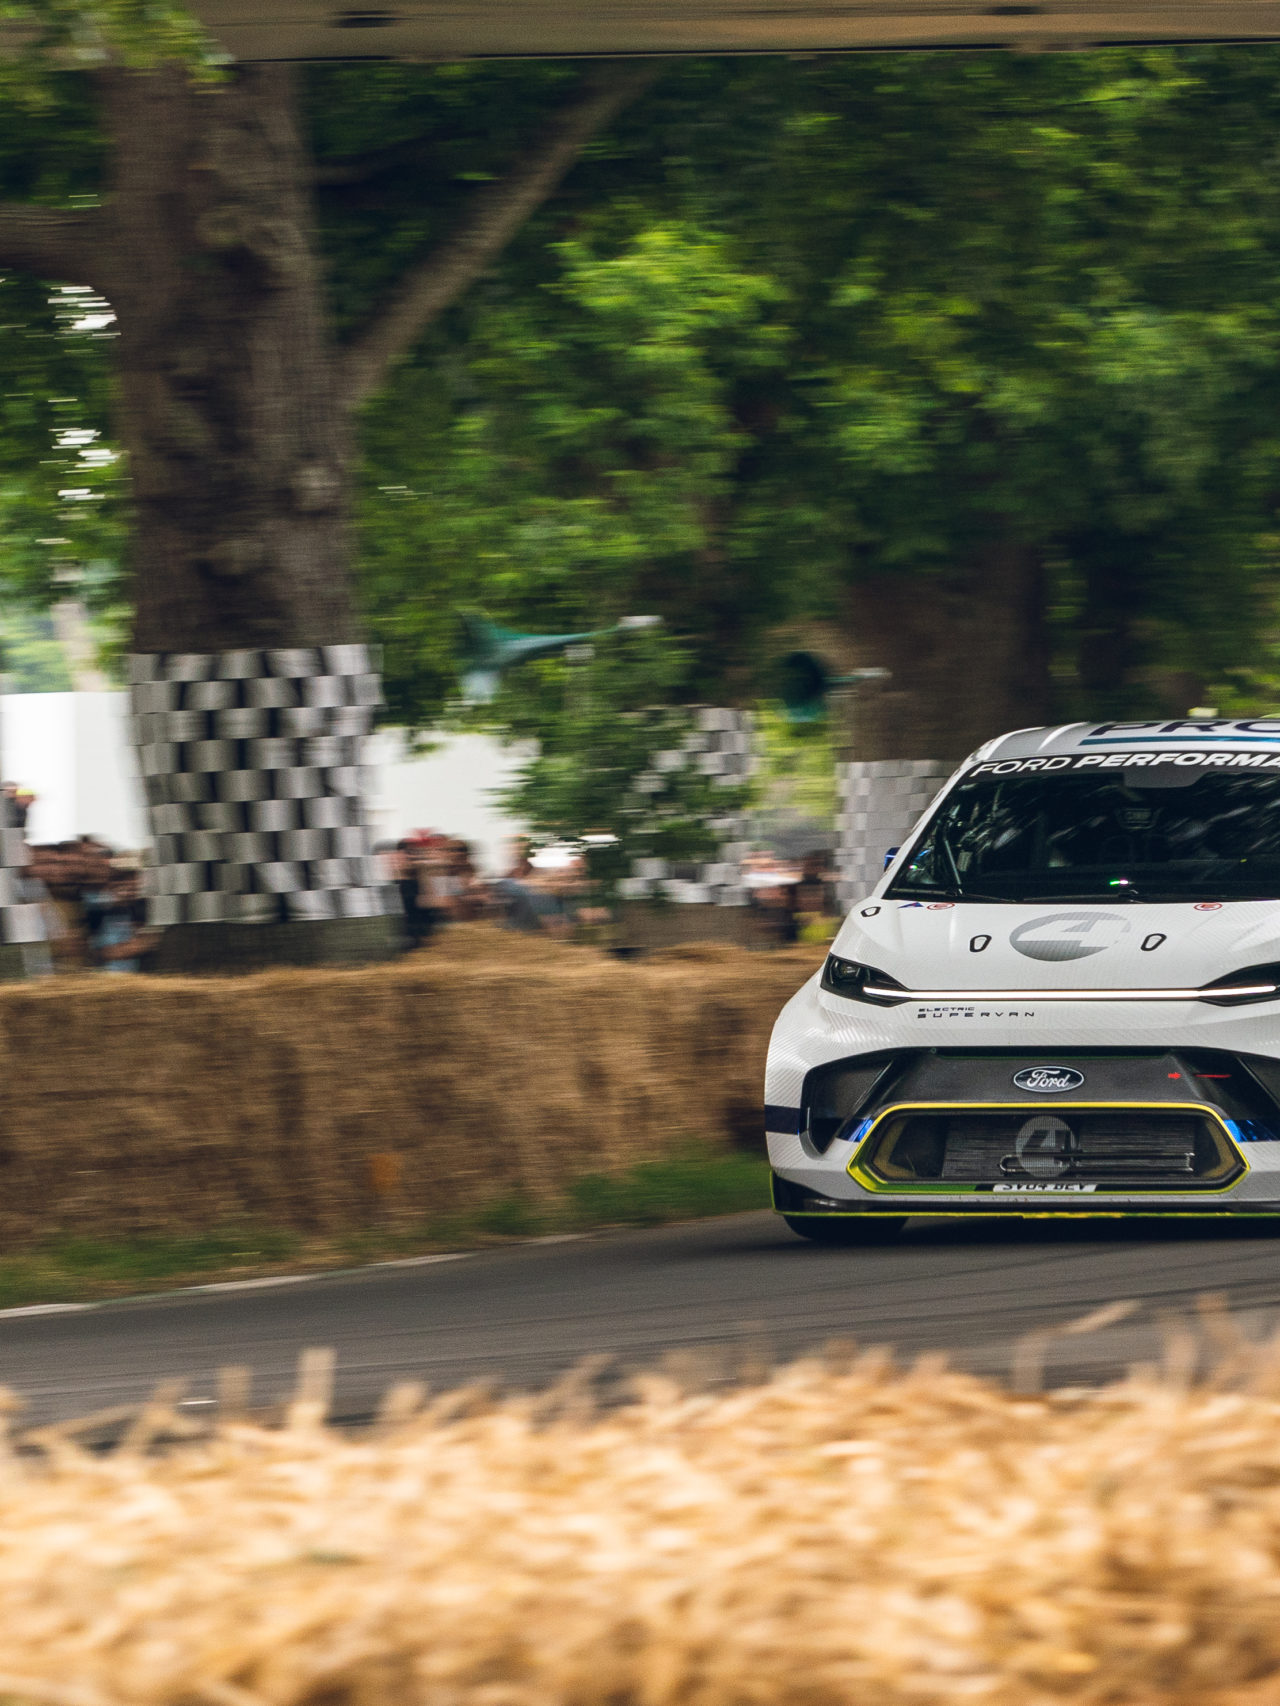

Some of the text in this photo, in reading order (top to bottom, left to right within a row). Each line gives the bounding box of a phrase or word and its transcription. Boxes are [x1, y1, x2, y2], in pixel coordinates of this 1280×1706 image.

[969, 757, 1072, 778] FORD
[917, 1011, 1035, 1019] SUPERVAN
[1026, 1068, 1071, 1088] Ford
